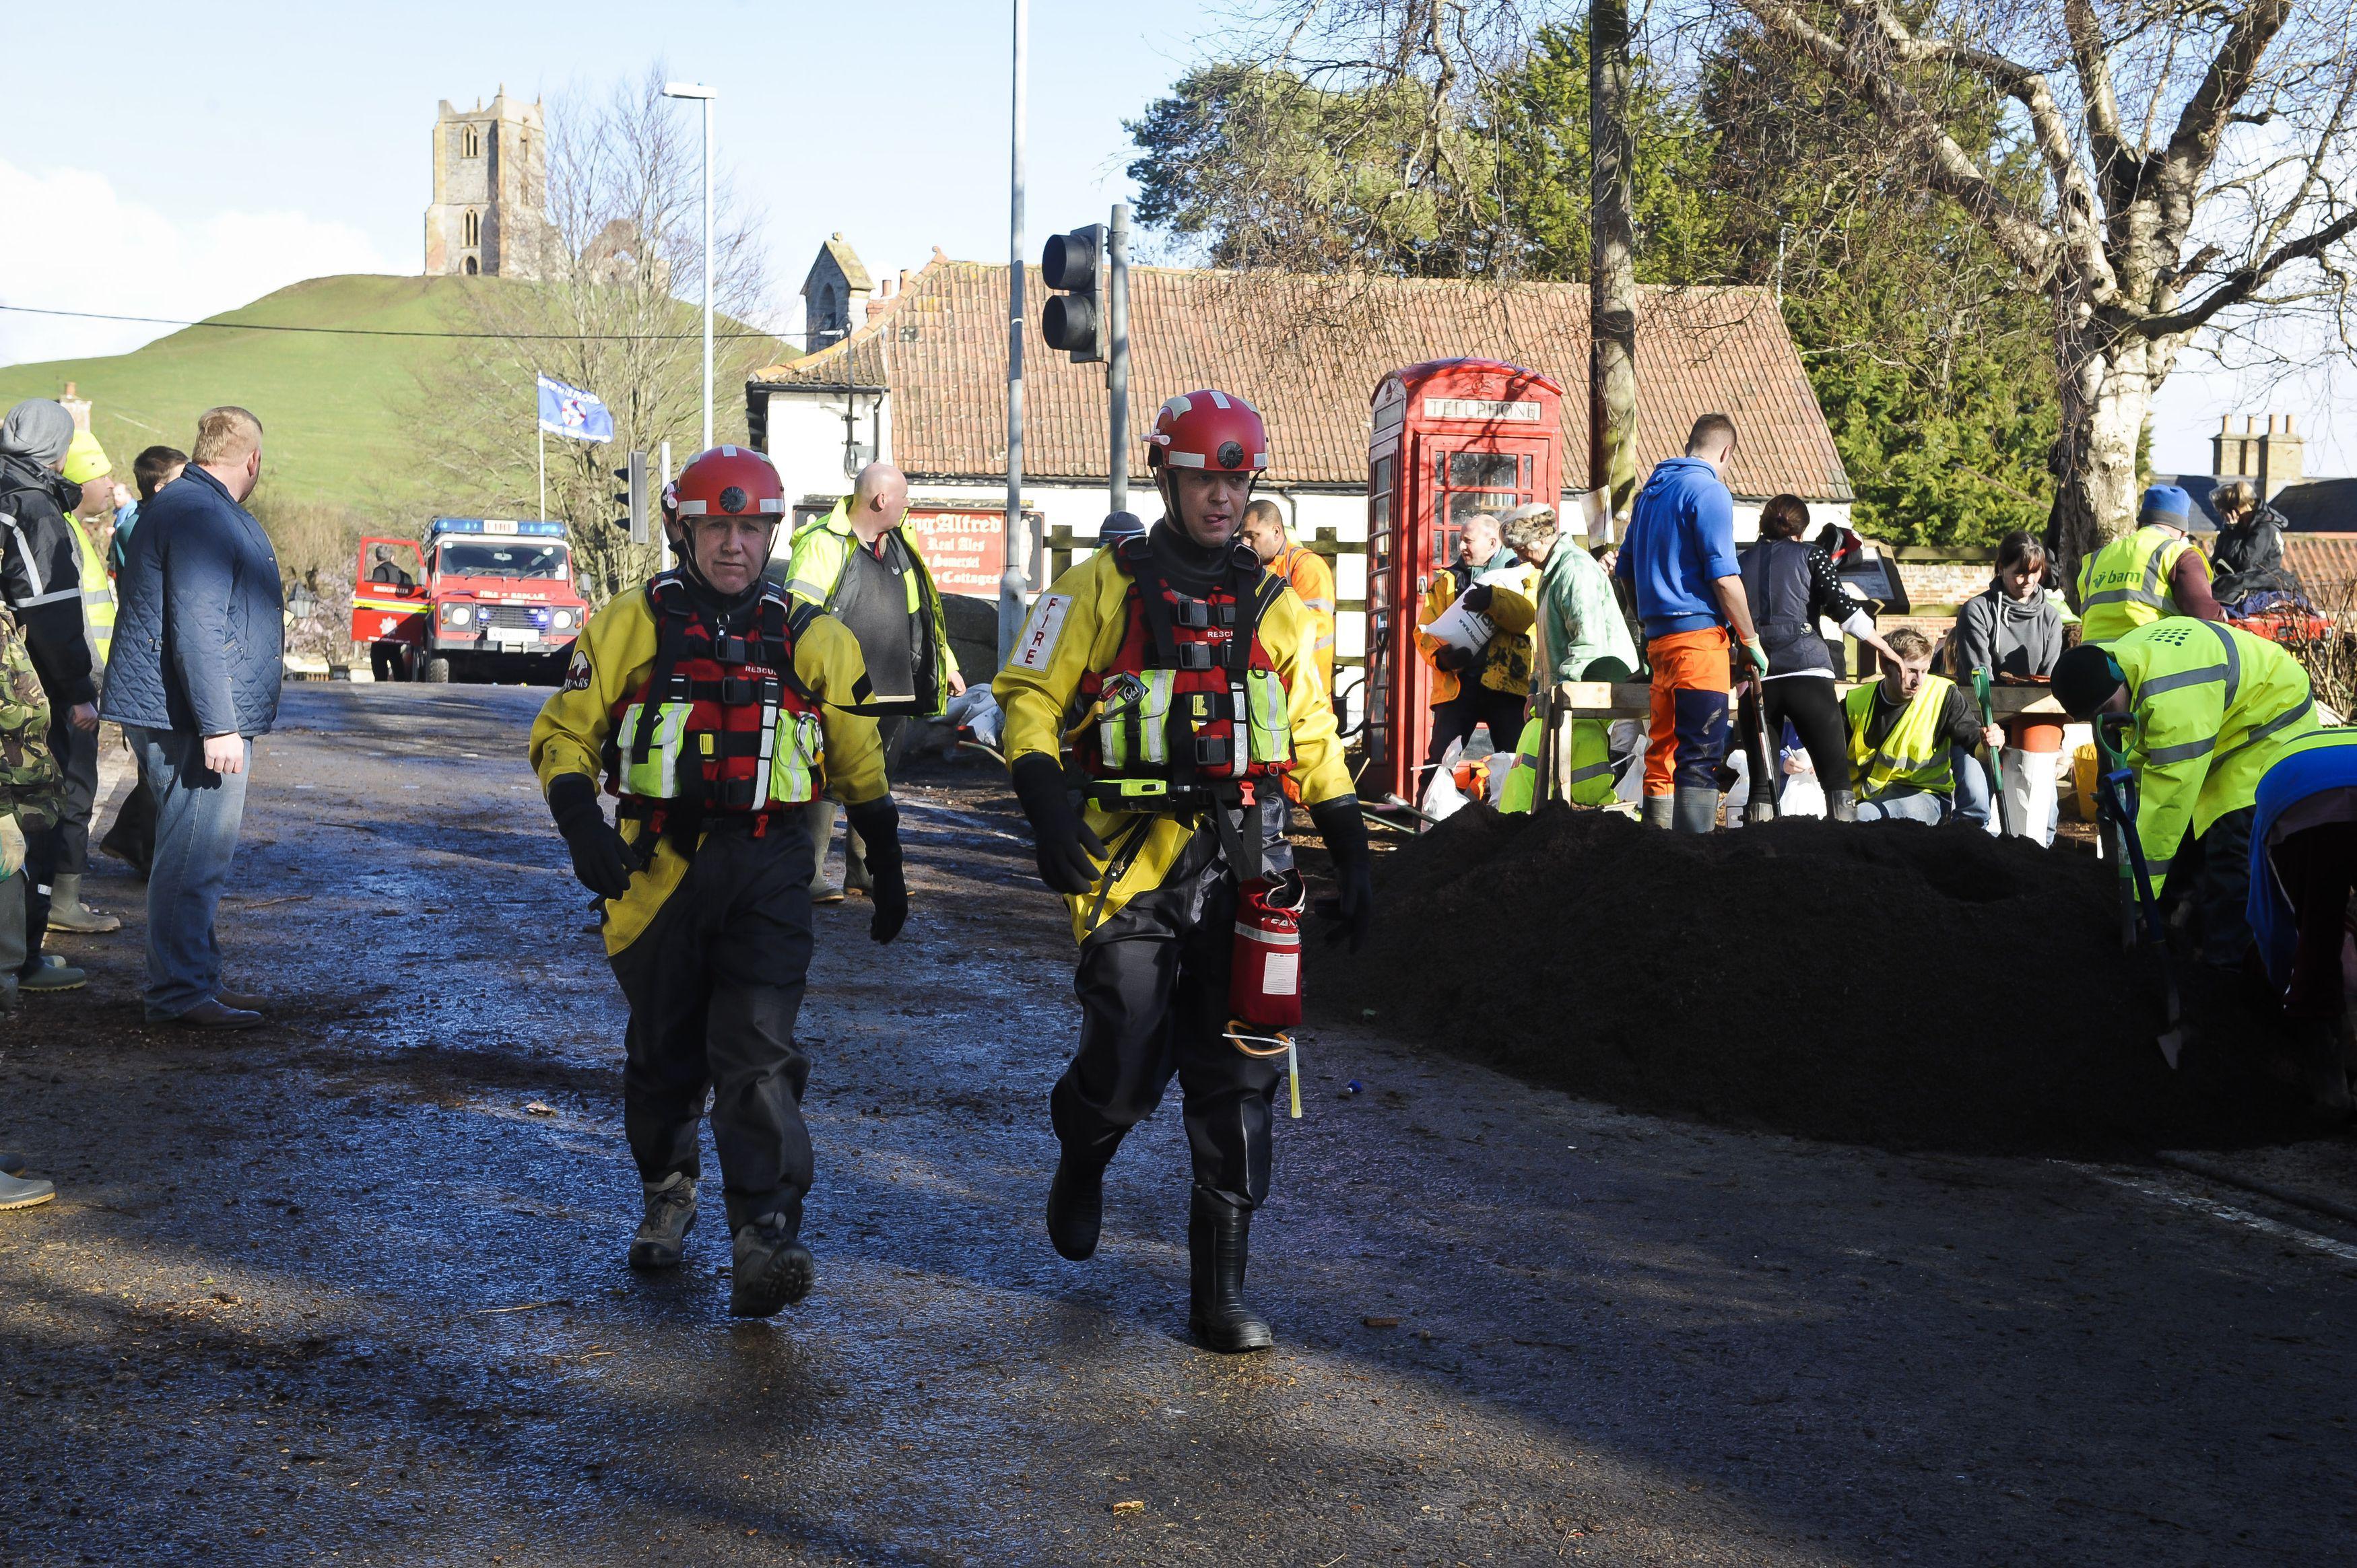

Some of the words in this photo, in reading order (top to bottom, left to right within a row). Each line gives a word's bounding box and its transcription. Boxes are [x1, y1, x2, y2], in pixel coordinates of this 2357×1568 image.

[1430, 400, 1535, 419] TELEPHONE
[936, 514, 1001, 533] Alfred
[927, 536, 955, 551] Real
[958, 537, 985, 551] Ales
[932, 553, 980, 568] Somerset
[941, 570, 1000, 586] Cottages
[2107, 570, 2141, 584] bam
[1024, 597, 1059, 664] FIRE
[745, 666, 776, 675] RESCU
